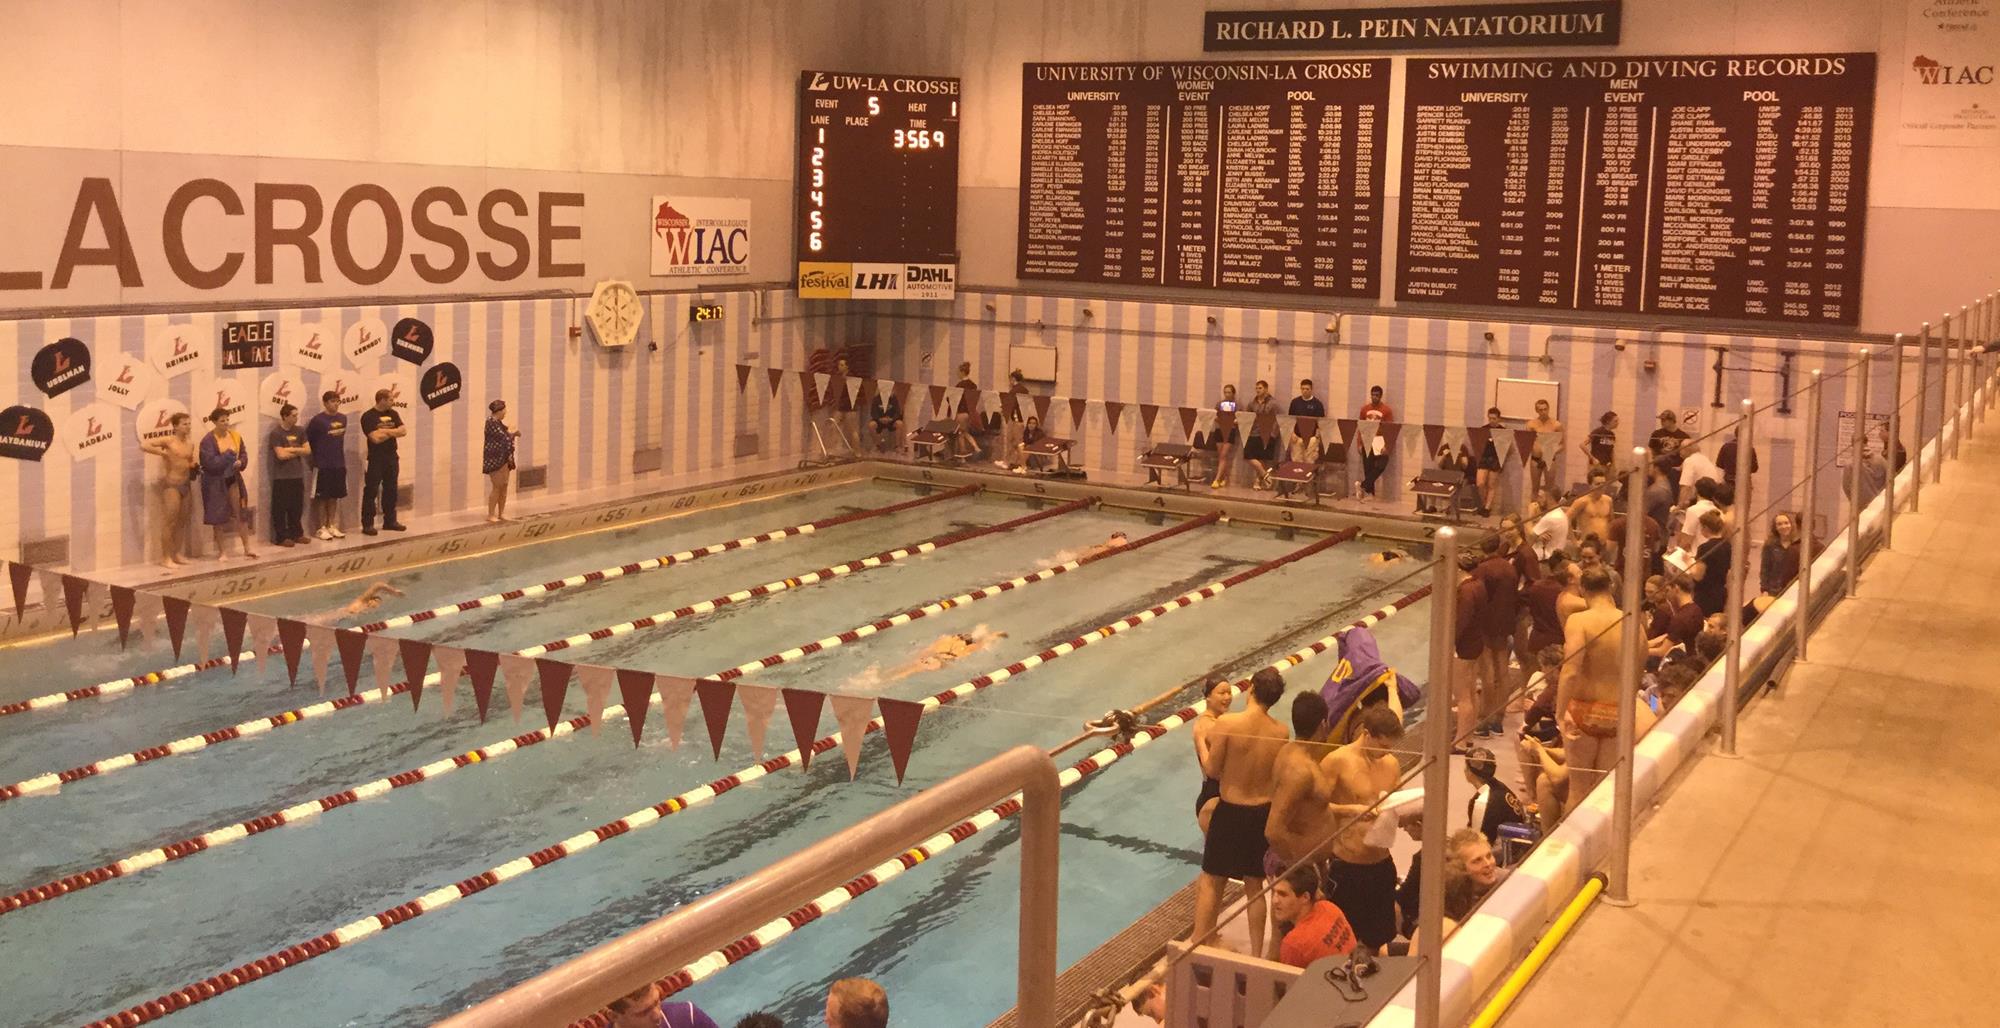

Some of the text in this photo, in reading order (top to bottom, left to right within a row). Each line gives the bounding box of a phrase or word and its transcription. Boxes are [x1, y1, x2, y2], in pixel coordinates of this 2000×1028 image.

[1216, 13, 1606, 40] RICHARD L. PEIN NATATORIUM
[1036, 63, 1373, 81] UNIVERSITY OF WISCONSIN-LA CROSSE
[1428, 57, 1847, 79] SWIMMING AND DIVING RECORDS
[1914, 65, 1994, 85] WIAC
[833, 75, 959, 95] UW-LA CROSSE
[1176, 80, 1214, 90] WOMEN
[1609, 79, 1638, 90] MEN
[1067, 91, 1120, 101] UNIVERSITY
[1178, 91, 1210, 101] EVENT
[1287, 91, 1316, 101] POOL
[1460, 92, 1528, 103] UNIVERSITY
[1603, 92, 1645, 103] EVENT
[1743, 91, 1780, 102] POOL
[815, 99, 839, 109] EVENT
[867, 96, 880, 115] 5
[908, 103, 927, 113] HEAT
[951, 101, 957, 117] 1
[810, 115, 830, 125] LANE
[845, 116, 869, 126] PLACE
[909, 119, 927, 128] TIME
[818, 128, 825, 144] 1
[811, 147, 825, 166] 2
[812, 168, 824, 187] 3
[810, 190, 823, 207] 4
[809, 210, 823, 229] 5
[161, 177, 586, 290] CROSSE
[660, 227, 748, 266] WIAC
[809, 232, 822, 251] 6
[669, 265, 748, 274] ATHLETIC CONFERENCE
[906, 266, 953, 283] DAHL
[1600, 264, 1631, 273] METER
[800, 271, 849, 289] festival
[695, 306, 723, 321] 24:17
[108, 384, 130, 396] JOLLY
[78, 432, 113, 450] NADEAU
[739, 485, 759, 497] 65
[1034, 482, 1046, 493] 5
[674, 495, 696, 509] 60
[603, 507, 626, 522] 55
[1281, 510, 1294, 522] 3
[523, 523, 550, 538] 50
[1423, 527, 1435, 538] 2
[439, 538, 465, 554] 45
[336, 556, 366, 573] 40
[221, 576, 256, 595] 35
